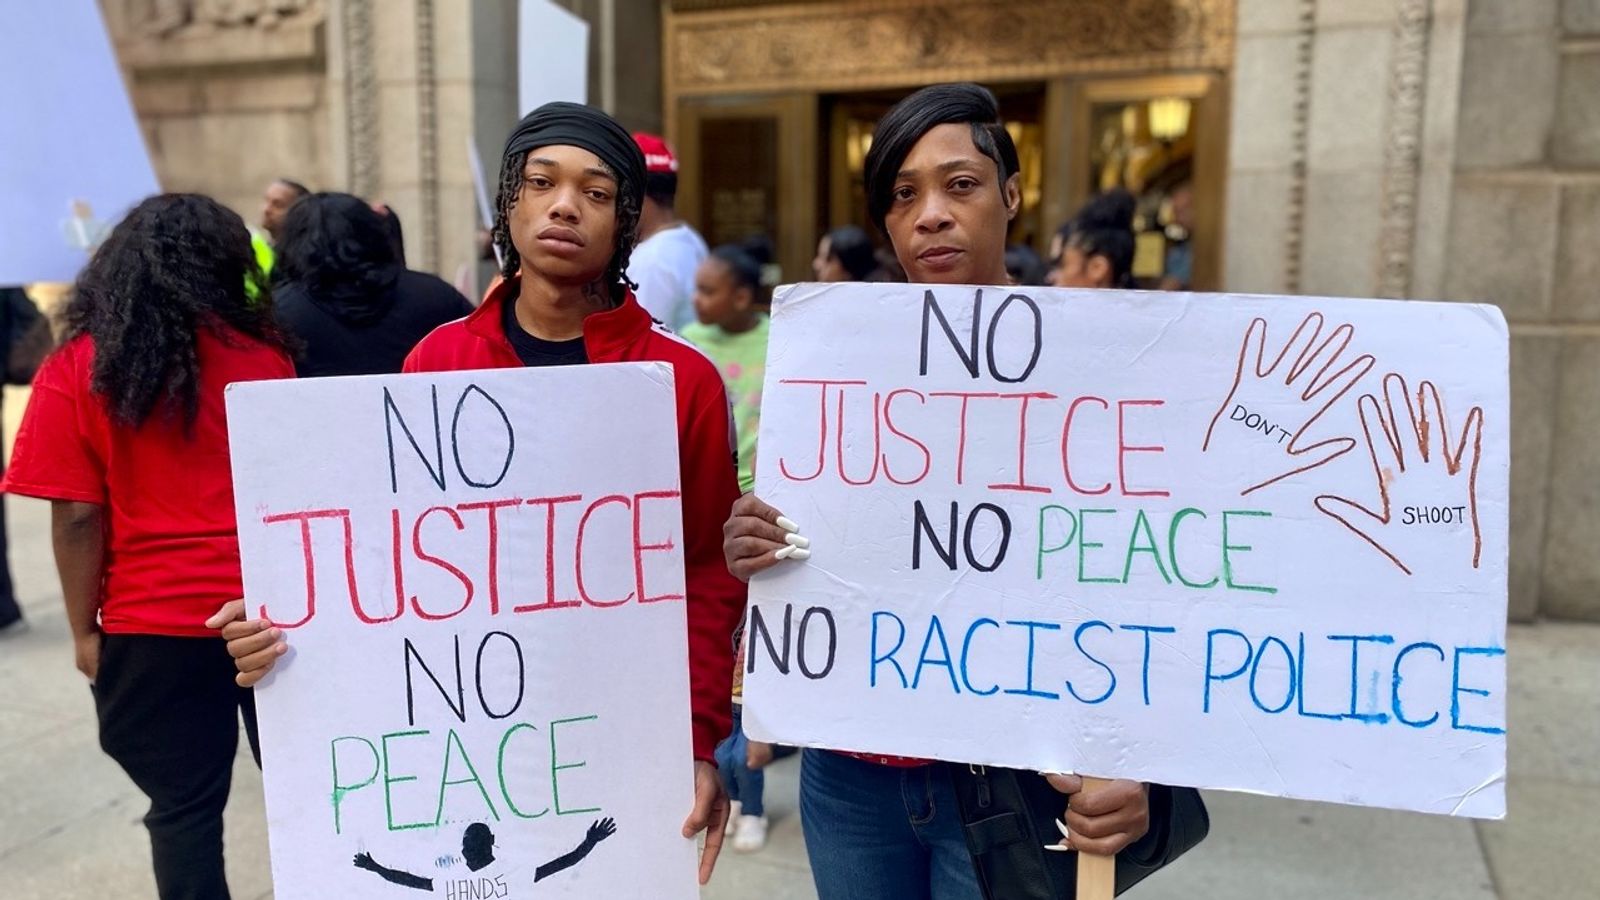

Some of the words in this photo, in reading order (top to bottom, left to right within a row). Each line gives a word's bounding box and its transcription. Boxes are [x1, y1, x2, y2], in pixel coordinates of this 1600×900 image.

[919, 288, 1043, 383] NO
[383, 383, 515, 494] NO
[778, 379, 1171, 497] JUSTICE
[1229, 404, 1293, 445] DON'T
[259, 489, 685, 629] JUSTICE
[911, 499, 1012, 573] NO
[1035, 504, 1278, 594] PEACE
[1401, 505, 1467, 526] SHOOT
[404, 631, 525, 726] NO
[746, 602, 838, 680] NO
[869, 610, 1176, 706] RACIST
[1203, 628, 1507, 735] POLICE
[331, 715, 602, 834] PEACE
[445, 873, 509, 900] HANDS
